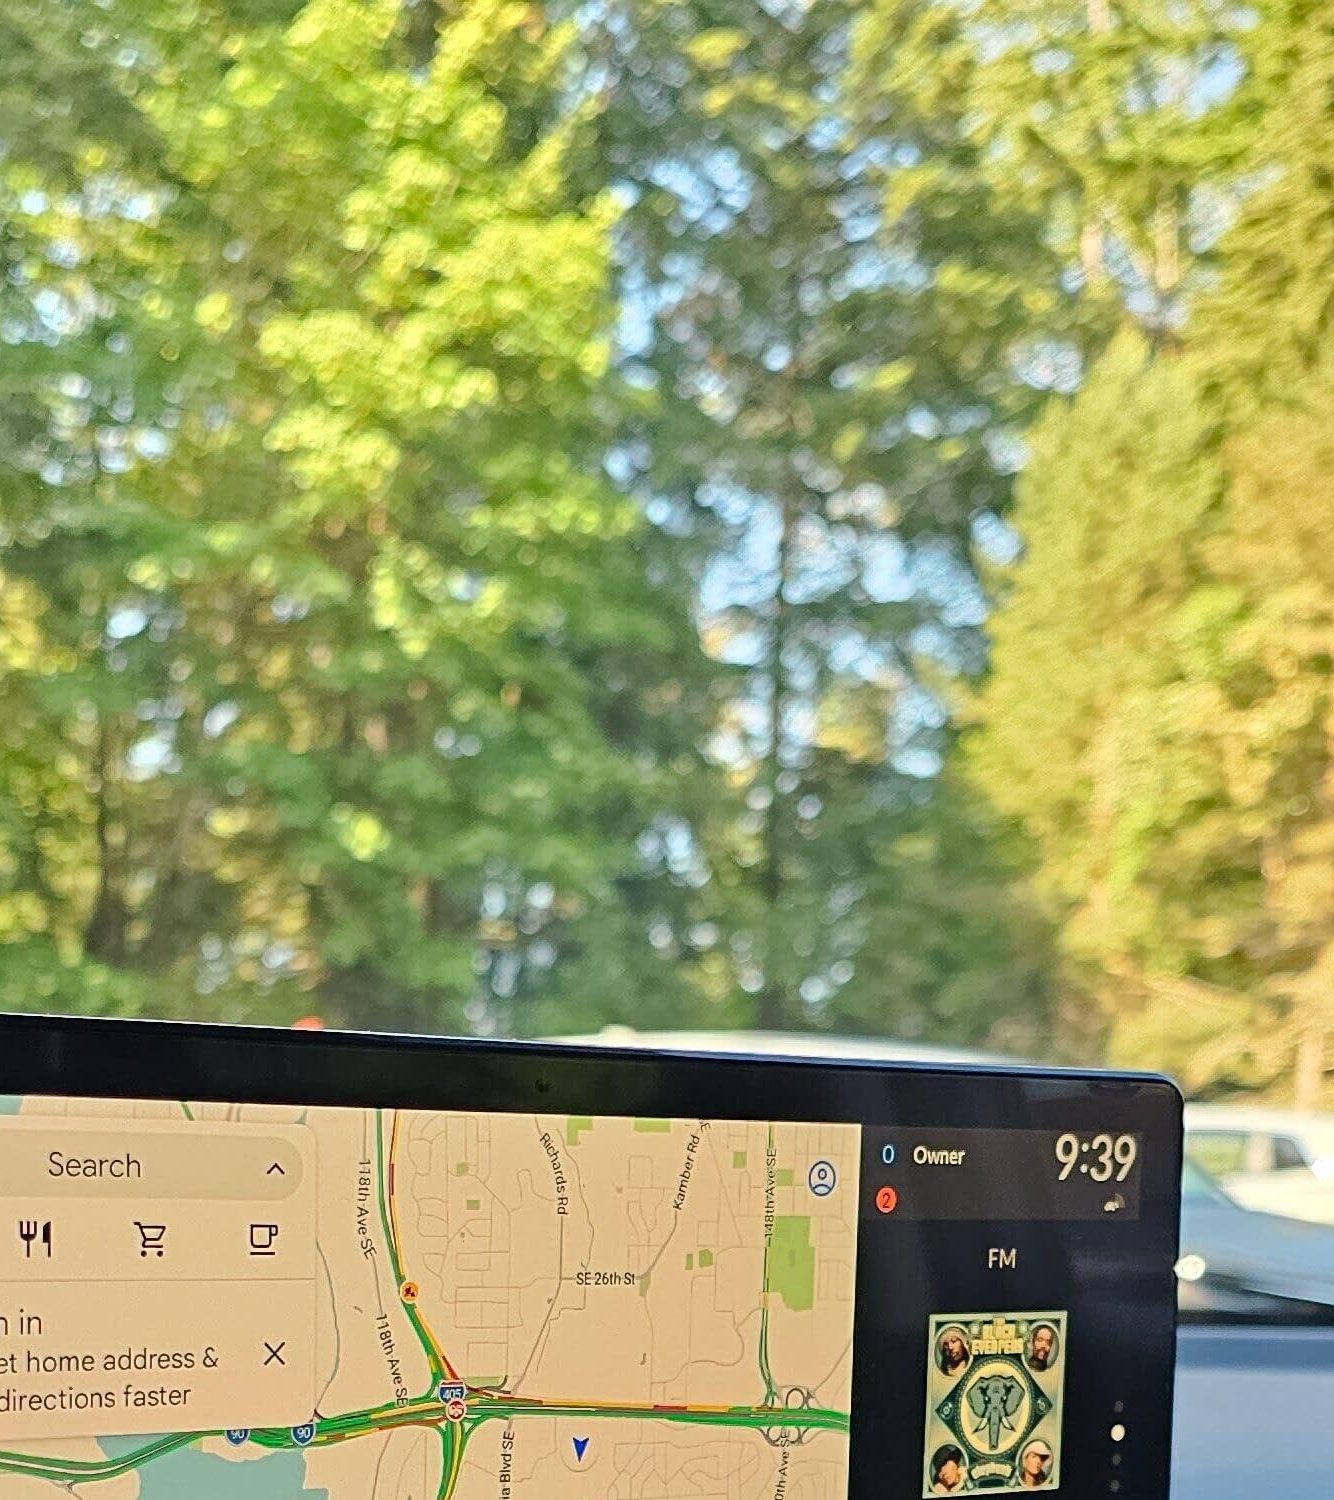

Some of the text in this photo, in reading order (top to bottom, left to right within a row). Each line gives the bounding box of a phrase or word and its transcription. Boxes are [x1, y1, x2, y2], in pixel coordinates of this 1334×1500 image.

[47, 1150, 142, 1179] Search
[913, 1145, 966, 1166] Owner
[1055, 1133, 1137, 1183] 9:39
[539, 1132, 568, 1216] Richards Rd
[673, 1156, 695, 1211] Kamber
[687, 1134, 700, 1154] Rd
[764, 1148, 777, 1239] 148th Ave SE
[357, 1160, 377, 1260] 118th Ave SE
[987, 1247, 1017, 1269] FM
[576, 1271, 636, 1286] SE 26th St
[19, 1308, 42, 1336] in
[26, 1350, 95, 1374] home
[103, 1346, 195, 1371] address
[202, 1346, 219, 1370] &
[376, 1313, 408, 1407] 118th Ave SE
[123, 1384, 191, 1408] faster
[501, 1431, 515, 1450] SE
[499, 1453, 512, 1483] Blvd
[778, 1451, 789, 1476] Ave
